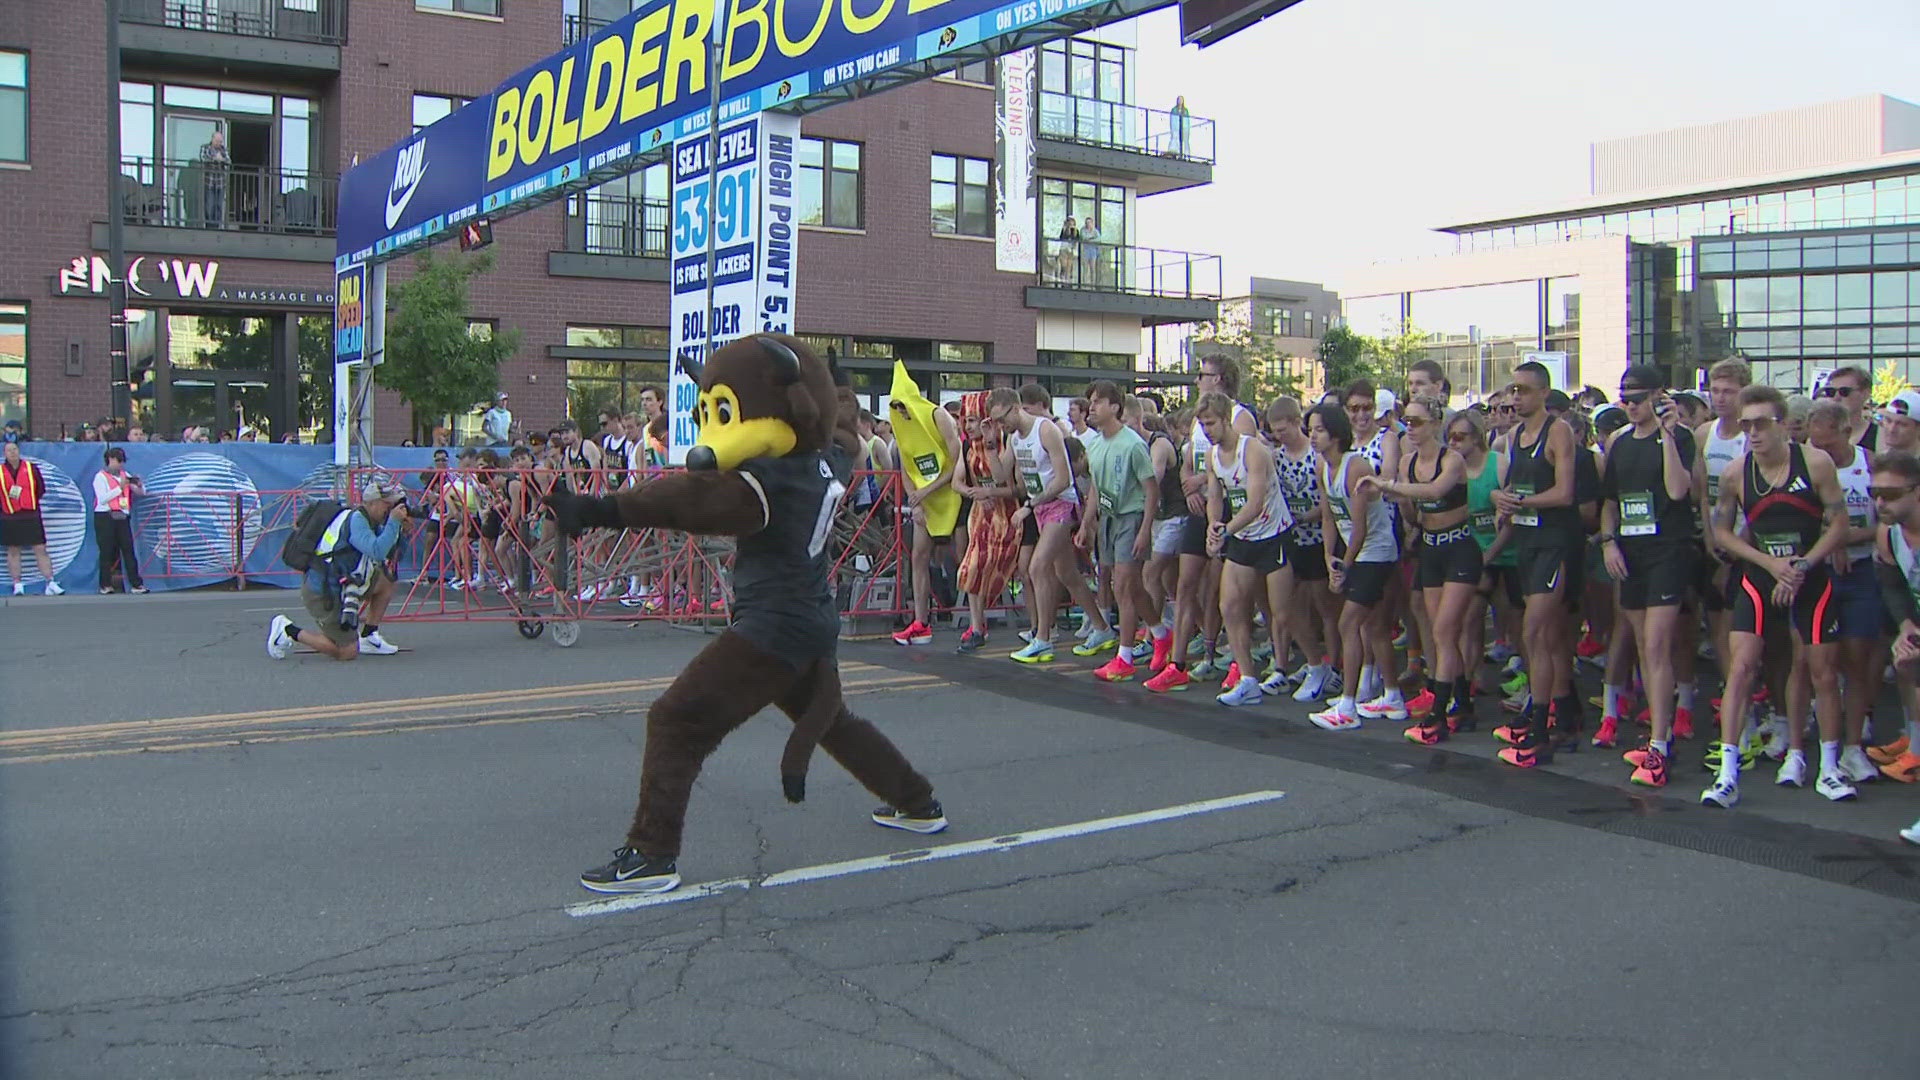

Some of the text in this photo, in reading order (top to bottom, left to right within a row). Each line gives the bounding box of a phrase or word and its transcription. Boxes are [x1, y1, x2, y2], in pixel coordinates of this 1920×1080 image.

[996, 11, 1011, 31] OH
[1014, 4, 1037, 25] YES
[1040, 0, 1064, 16] YOU
[823, 45, 900, 86] OH YES YOU CAN!
[683, 116, 692, 134] OH
[693, 112, 706, 130] YES
[729, 96, 750, 117] WILL!
[1009, 65, 1023, 137] LEASING
[393, 137, 426, 191] RUN
[596, 152, 606, 166] YES
[606, 147, 617, 162] YOU
[679, 128, 754, 176] SEA LEVEL
[517, 184, 525, 197] YES
[525, 181, 534, 194] YOU
[760, 134, 792, 334] HIGH POINT 5,3
[59, 256, 219, 298] The NOW
[676, 253, 751, 285] IS FOR SLACKERS
[220, 290, 228, 298] A
[238, 290, 307, 302] MASSAGE
[339, 275, 361, 305] BOLD
[338, 301, 362, 330] SPEED
[682, 304, 741, 341] BOLDER
[337, 326, 362, 355] AHEAD
[1626, 503, 1648, 515] A006
